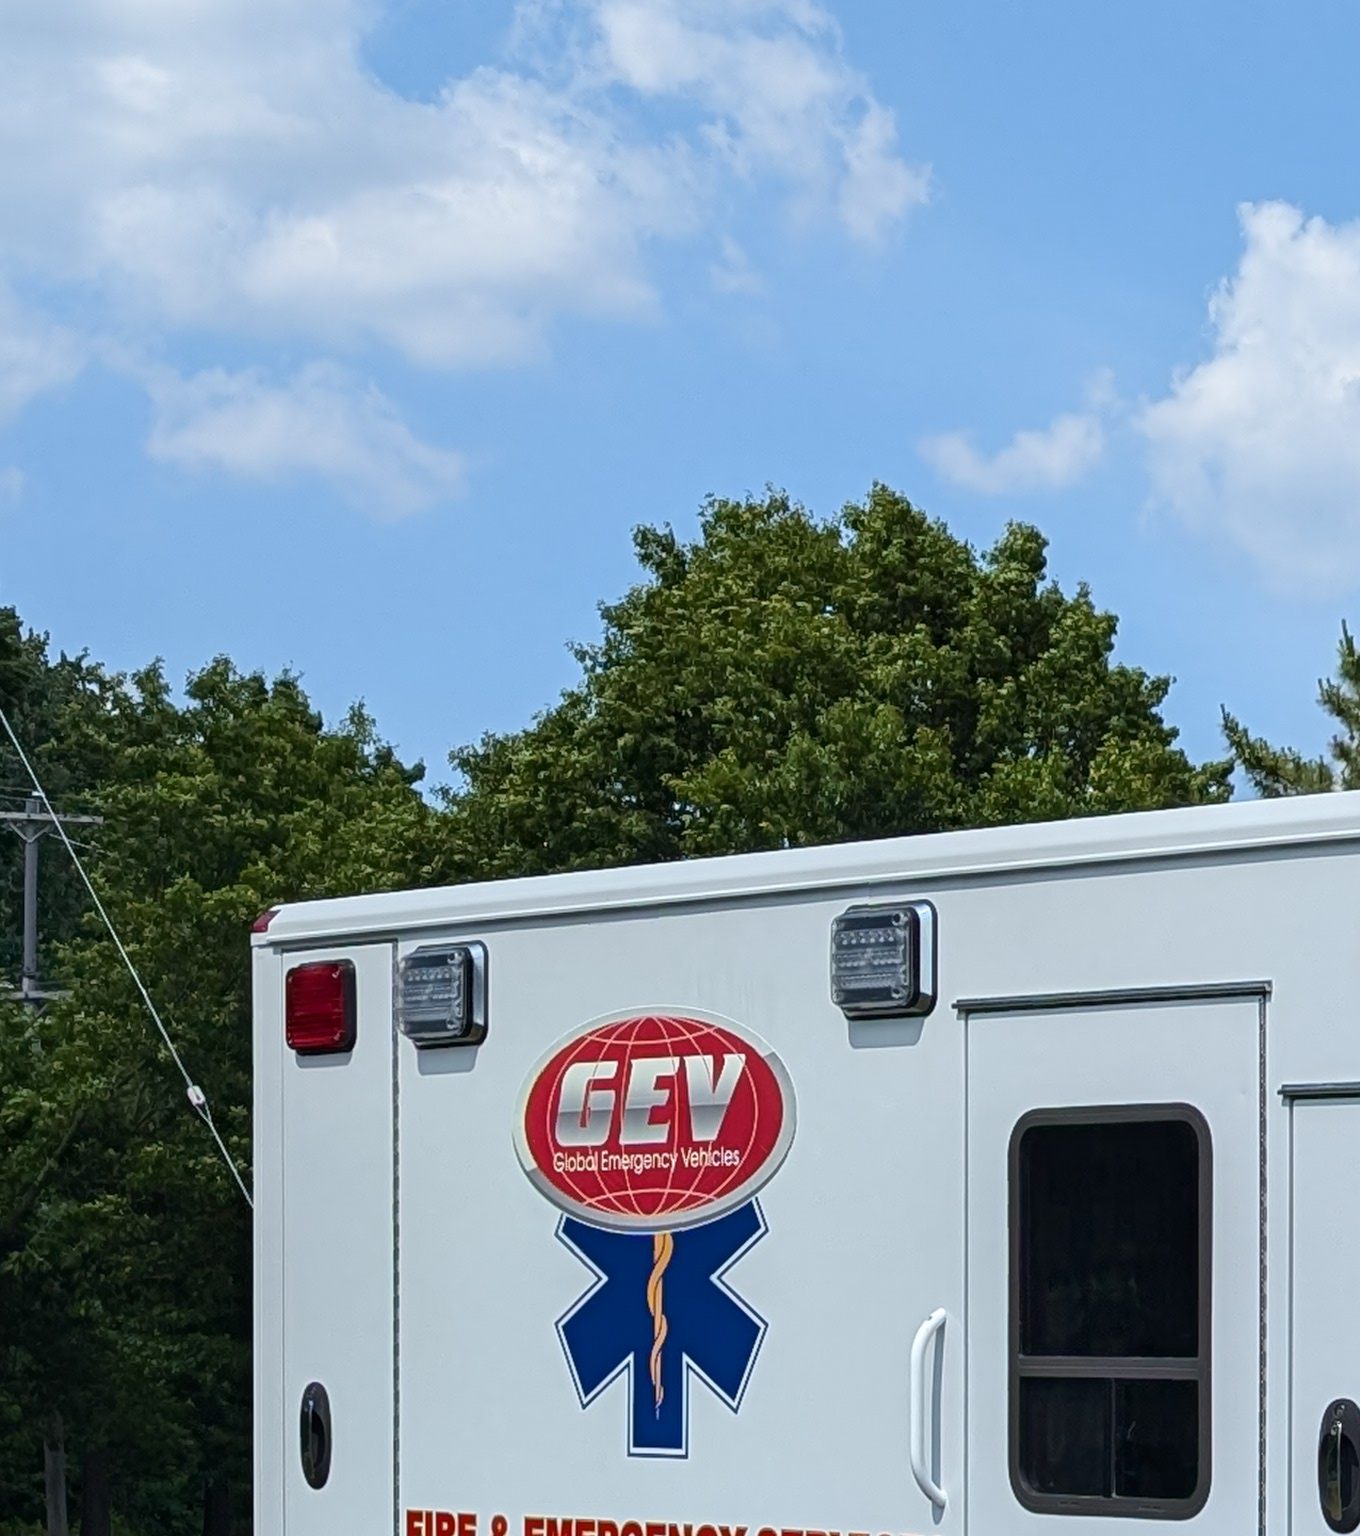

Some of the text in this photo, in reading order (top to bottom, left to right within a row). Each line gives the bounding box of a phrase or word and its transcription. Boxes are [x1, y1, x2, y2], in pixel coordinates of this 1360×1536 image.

[554, 1053, 746, 1148] GEV
[553, 1146, 741, 1175] Global Emergency Vehicles
